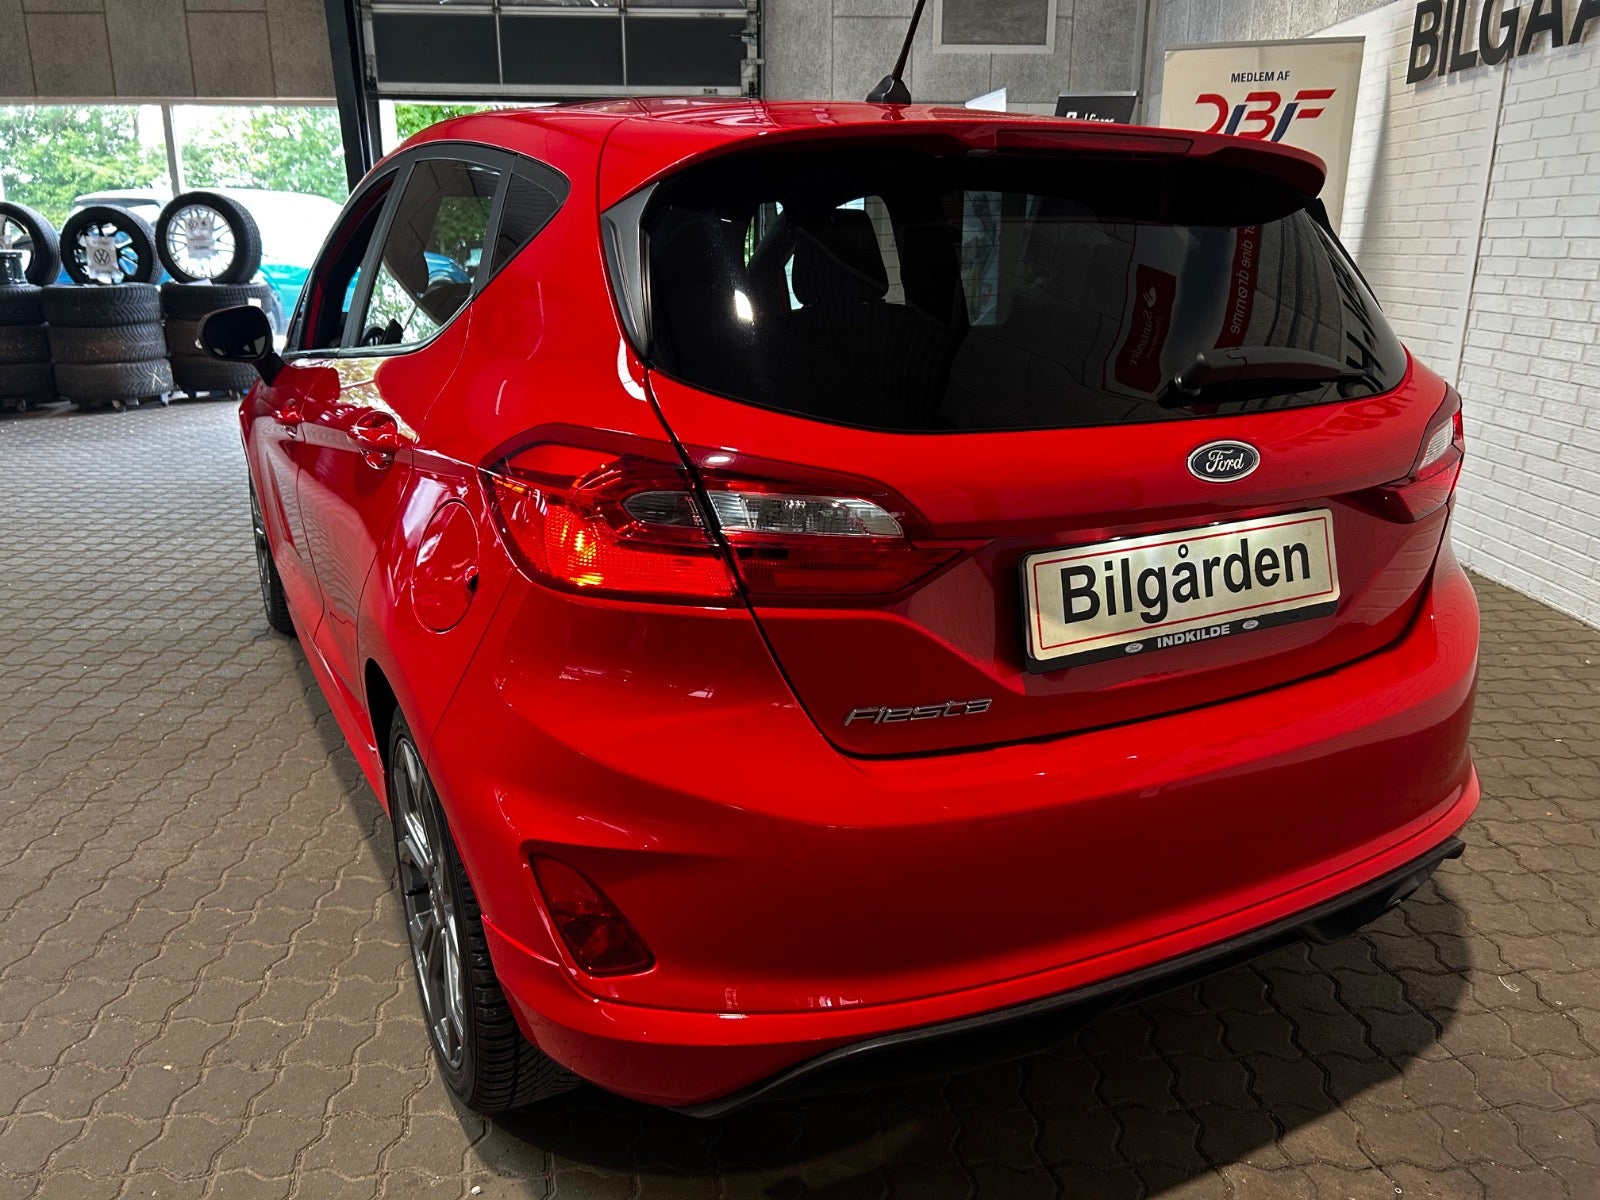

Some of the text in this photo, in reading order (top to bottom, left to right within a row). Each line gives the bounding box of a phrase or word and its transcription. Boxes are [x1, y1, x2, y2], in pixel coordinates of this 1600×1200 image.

[1231, 70, 1291, 83] MEDLEM AF
[1205, 449, 1245, 473] Ford
[1060, 538, 1311, 624] Bilgården
[1157, 624, 1231, 648] INDKILDE
[844, 698, 993, 726] Fiesta
